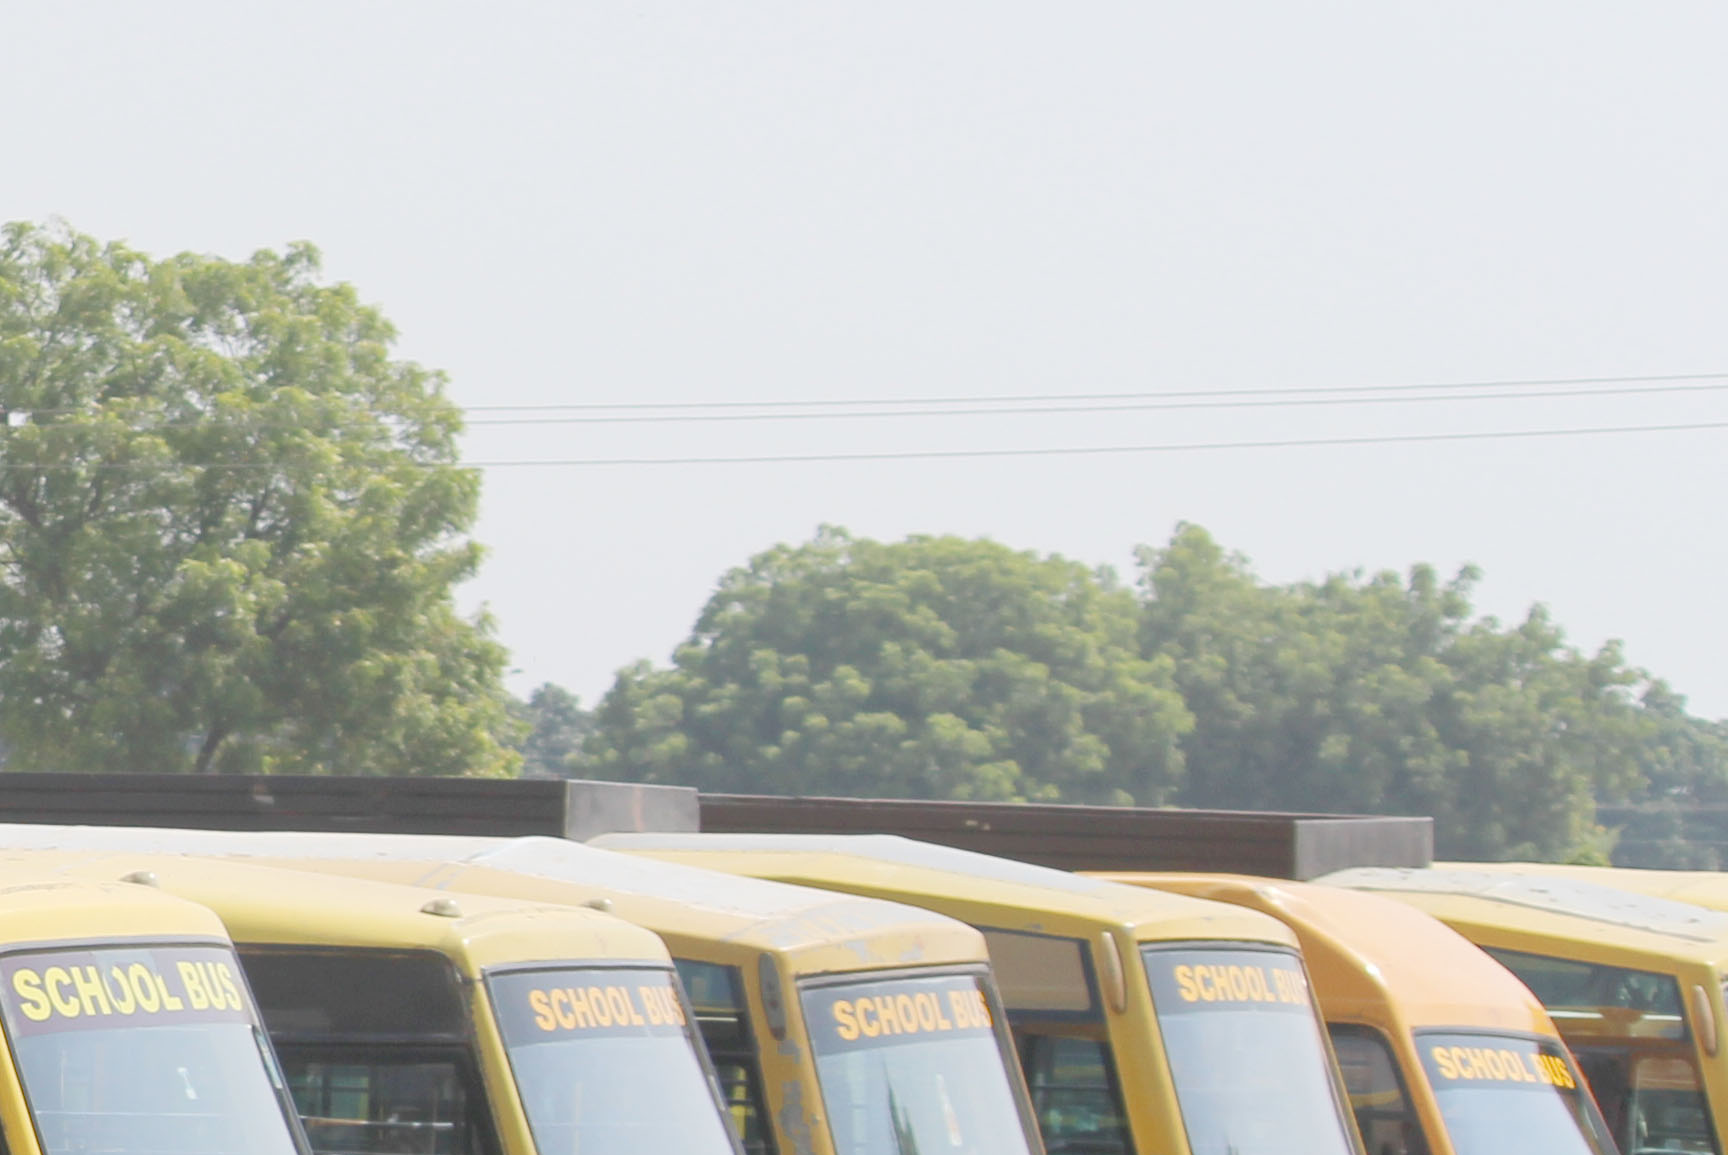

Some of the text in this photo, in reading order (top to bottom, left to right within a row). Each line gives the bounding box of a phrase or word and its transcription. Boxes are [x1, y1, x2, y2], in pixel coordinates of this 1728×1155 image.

[12, 960, 243, 1022] SCHOOL BUS
[1174, 964, 1275, 1003] SCHOOL
[528, 985, 687, 1031] SCHOOL BUS
[832, 989, 993, 1041] SCHOOL BUS
[1433, 1046, 1576, 1090] SCHOOL BUS
